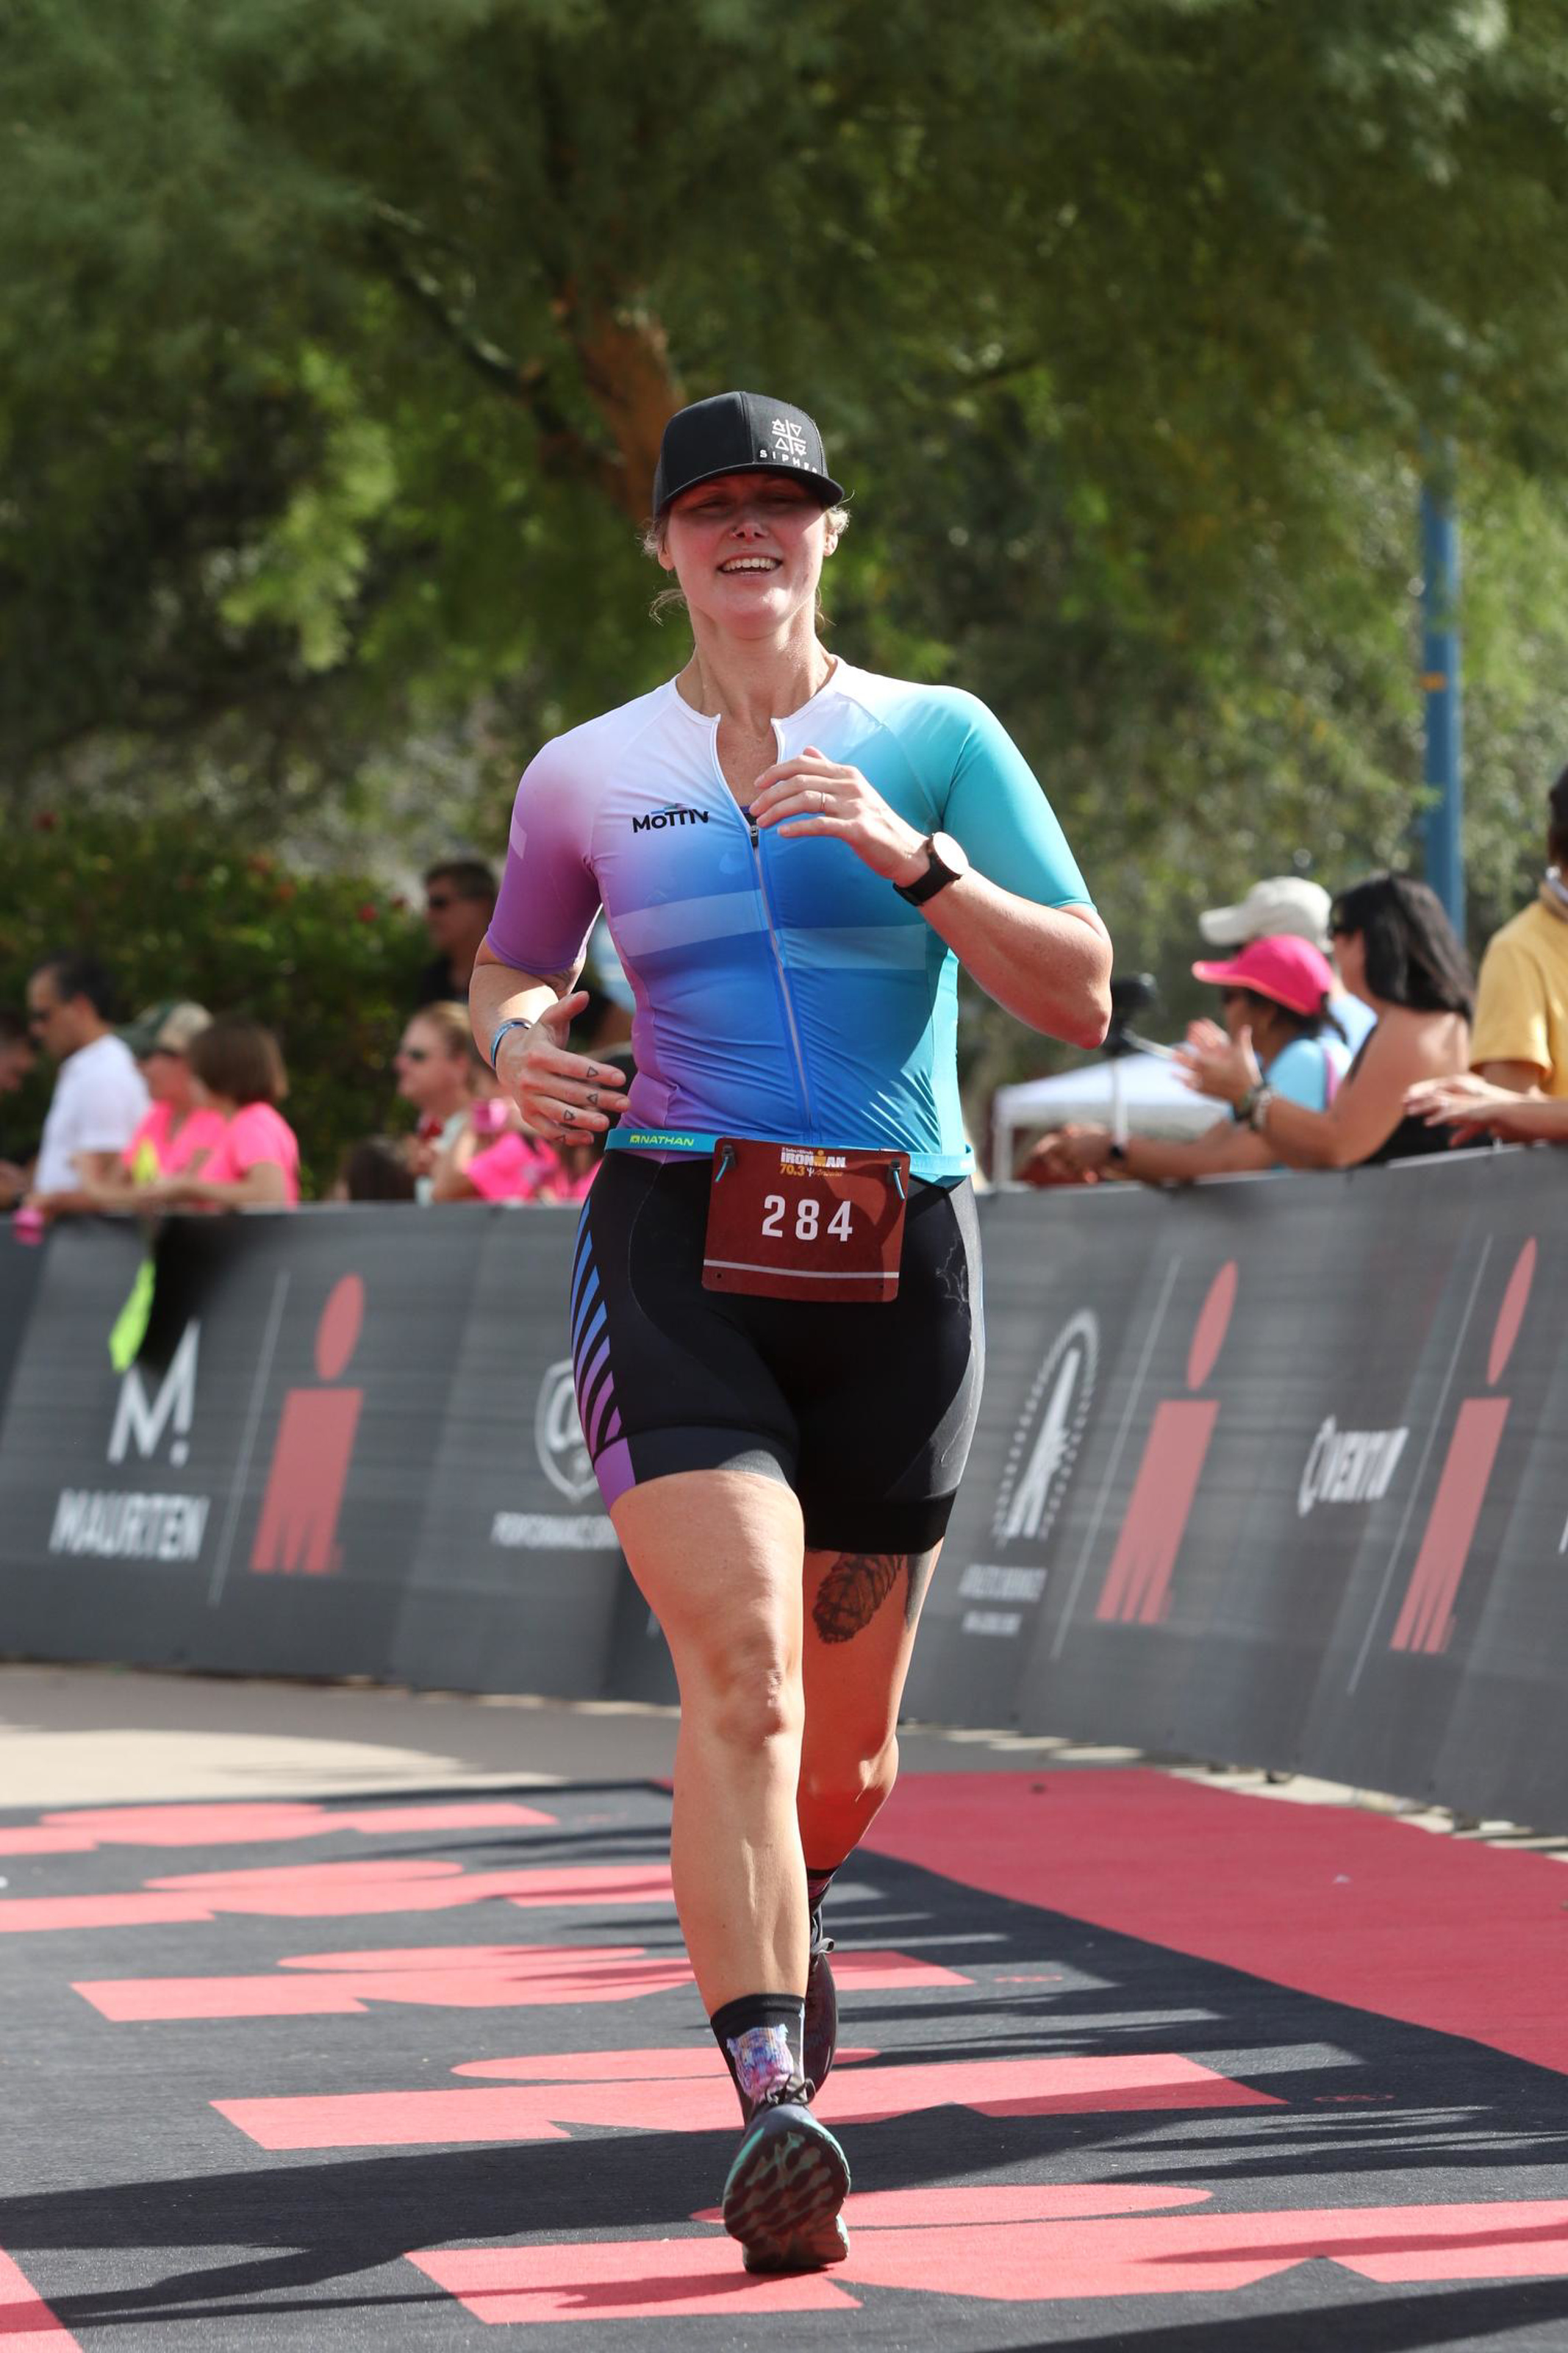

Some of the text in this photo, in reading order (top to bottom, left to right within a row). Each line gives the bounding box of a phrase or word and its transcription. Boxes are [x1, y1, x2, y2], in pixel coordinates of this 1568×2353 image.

[640, 1135, 694, 1146] NATHAN
[781, 1150, 846, 1168] IRONMAN
[779, 1164, 806, 1176] 70.3
[762, 1195, 853, 1242] 284
